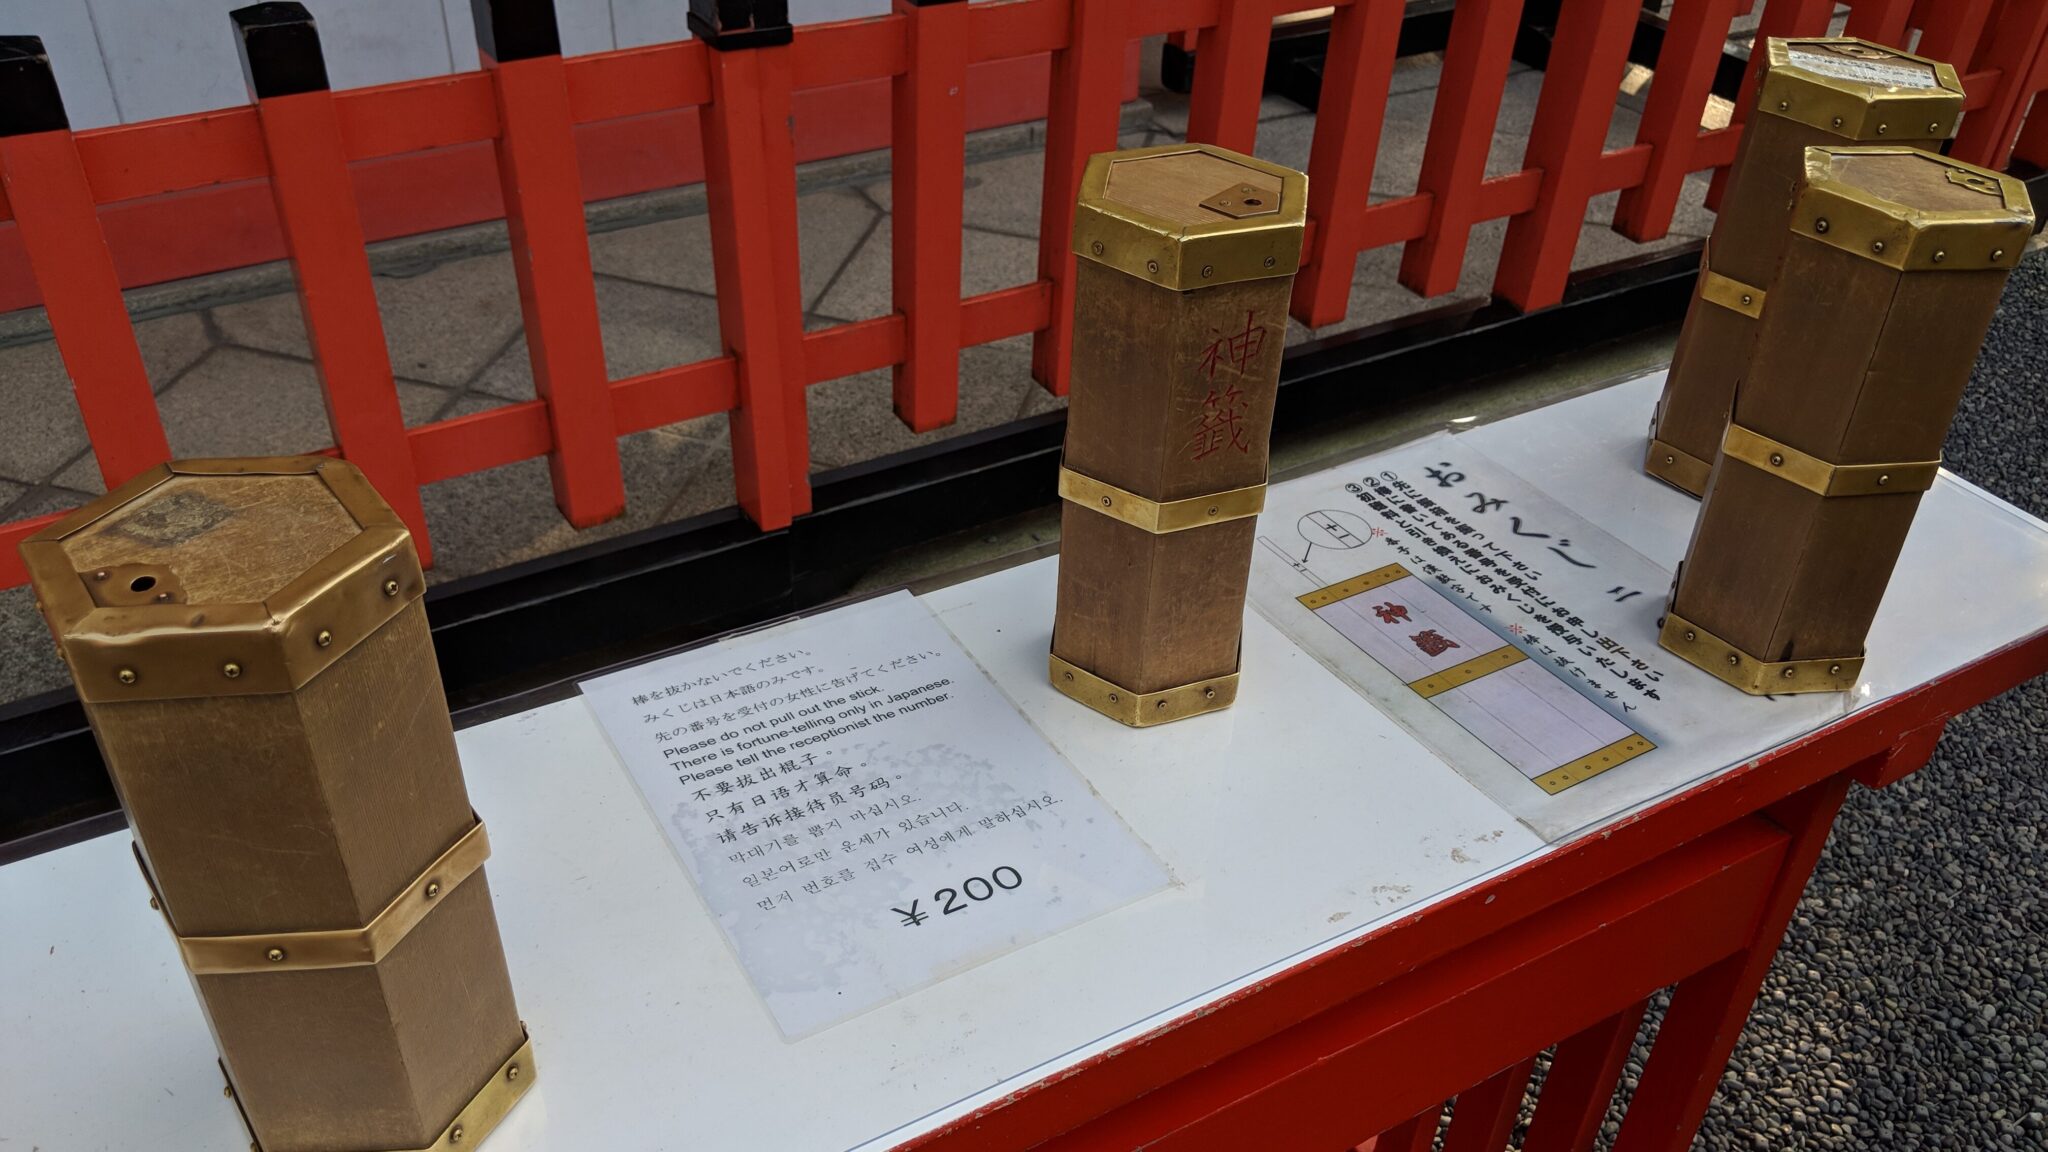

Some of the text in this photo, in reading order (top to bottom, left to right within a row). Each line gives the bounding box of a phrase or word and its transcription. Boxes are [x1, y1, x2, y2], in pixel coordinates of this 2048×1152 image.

[1423, 462, 1597, 569] おみくじ
[632, 649, 812, 706] 棒を抜かないでください。
[643, 665, 824, 724] みくじは日本語のみです。
[655, 650, 941, 744] 先の番号を受付の女性に告げてください。
[663, 685, 885, 760] Please do not pull out the stick.
[670, 678, 955, 773] There is fortune-telling only in Japanese.
[679, 692, 955, 786] Please tell the receptionist the number.
[691, 750, 833, 802] 不要拔出棍子。
[705, 762, 868, 823] 只有日语才算命。
[716, 775, 902, 845] 请告诉接待员号码。
[728, 794, 922, 863] 막대기를 뽑지 마십시오.
[742, 801, 970, 888] 일본어로만 운세가 있습니다.
[756, 890, 794, 911] 먼저
[802, 868, 856, 895] 번호를
[864, 853, 898, 873] 접수
[978, 795, 1064, 830] 말하십시오.
